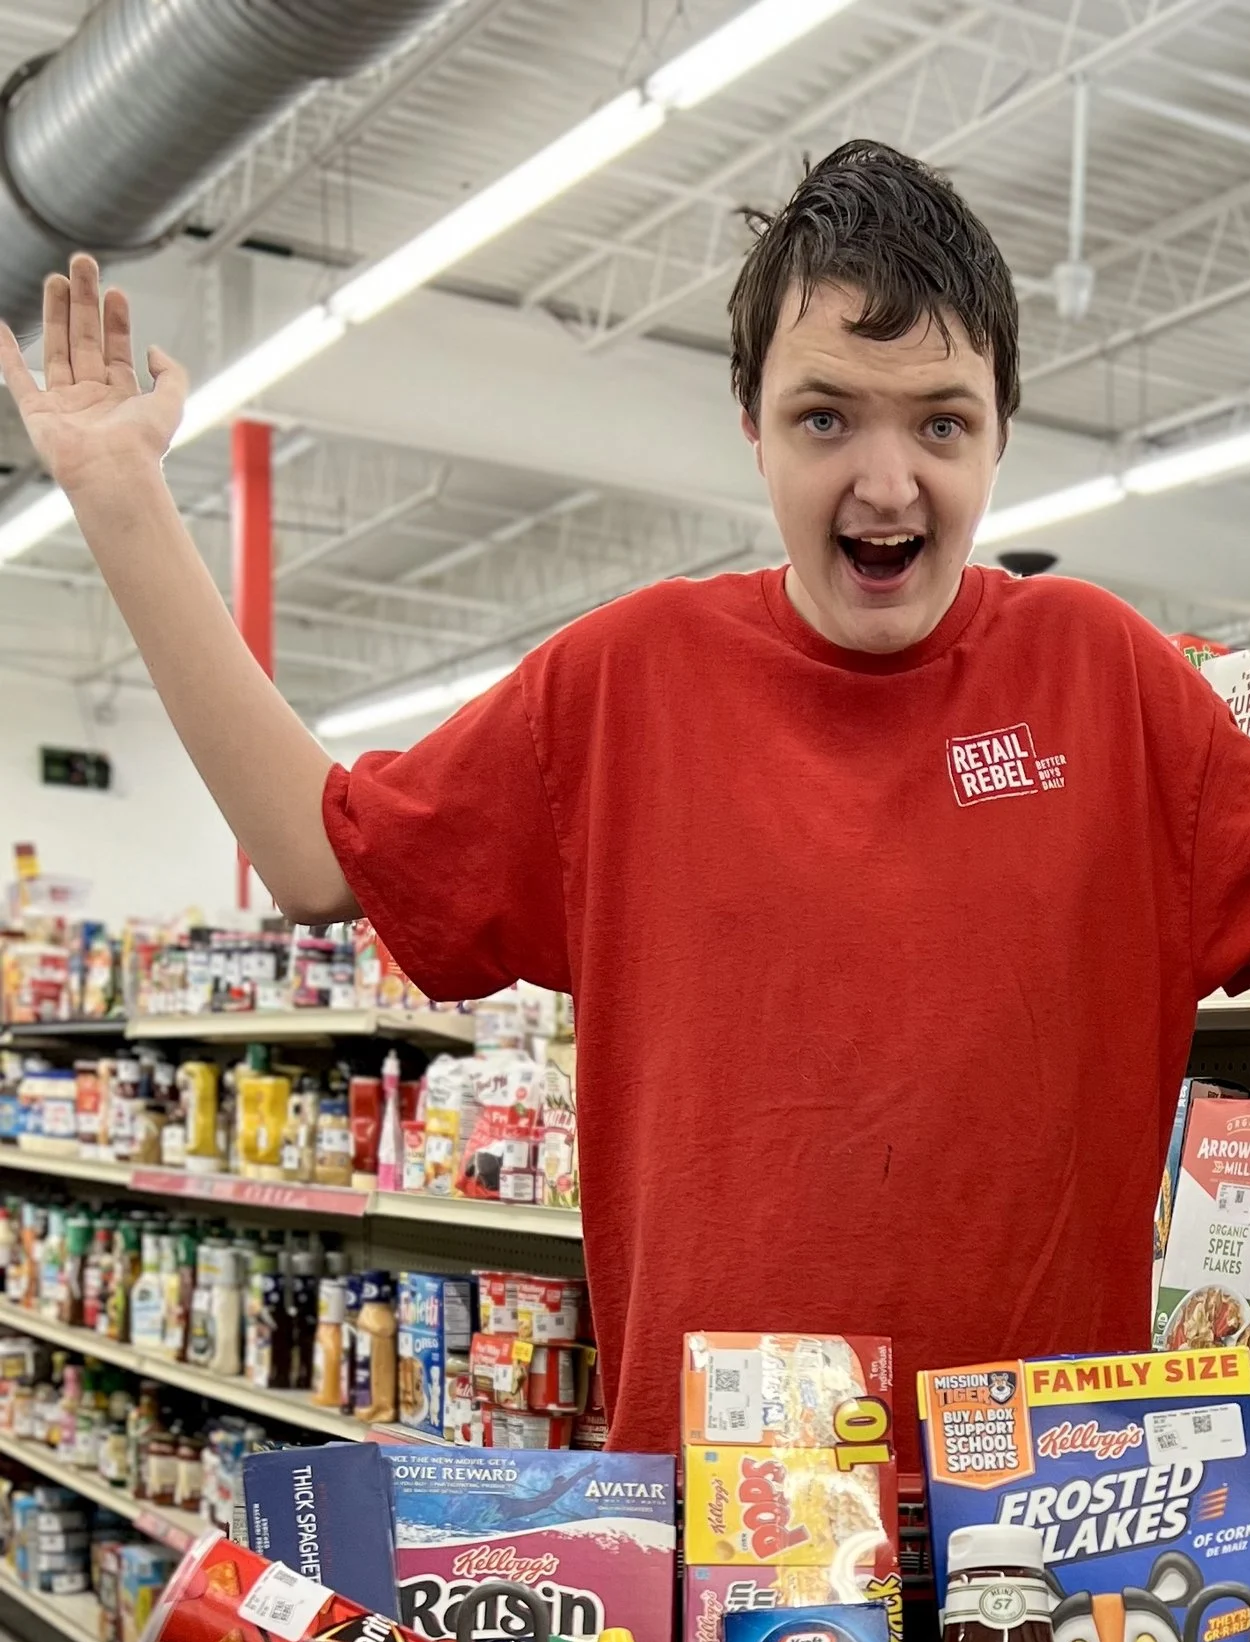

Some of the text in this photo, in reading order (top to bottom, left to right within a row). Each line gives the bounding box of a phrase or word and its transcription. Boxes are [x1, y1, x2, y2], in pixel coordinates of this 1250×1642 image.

[952, 733, 1029, 774] RETAIL
[1035, 755, 1067, 770] BETTER
[961, 759, 1034, 798] REBEL
[1038, 767, 1061, 781] BUYS
[1042, 777, 1065, 791] DAILY
[1208, 1223, 1249, 1239] ORGANIC
[1207, 1238, 1244, 1258] SPELT
[1203, 1255, 1242, 1275] FLAKES
[934, 1374, 988, 1390] MISSION
[1033, 1354, 1240, 1395] FAMILY SIZE
[944, 1408, 1014, 1424] BUY A BOX
[834, 1396, 892, 1472] 10
[944, 1421, 1015, 1438] SUPPORT
[945, 1435, 1017, 1454] SCHOOL
[1038, 1422, 1144, 1459] Kellogg's
[947, 1451, 1019, 1472] SPORTS
[443, 1466, 517, 1481] REWARD
[292, 1465, 315, 1511] THICK
[585, 1480, 666, 1499] AVATAR
[999, 1460, 1204, 1526] FROSTED
[708, 1478, 729, 1535] Kellogg's
[1193, 1535, 1214, 1550] OF
[991, 1587, 1014, 1598] HEINZ
[398, 1580, 597, 1639] Raisin
[992, 1598, 1013, 1611] 57
